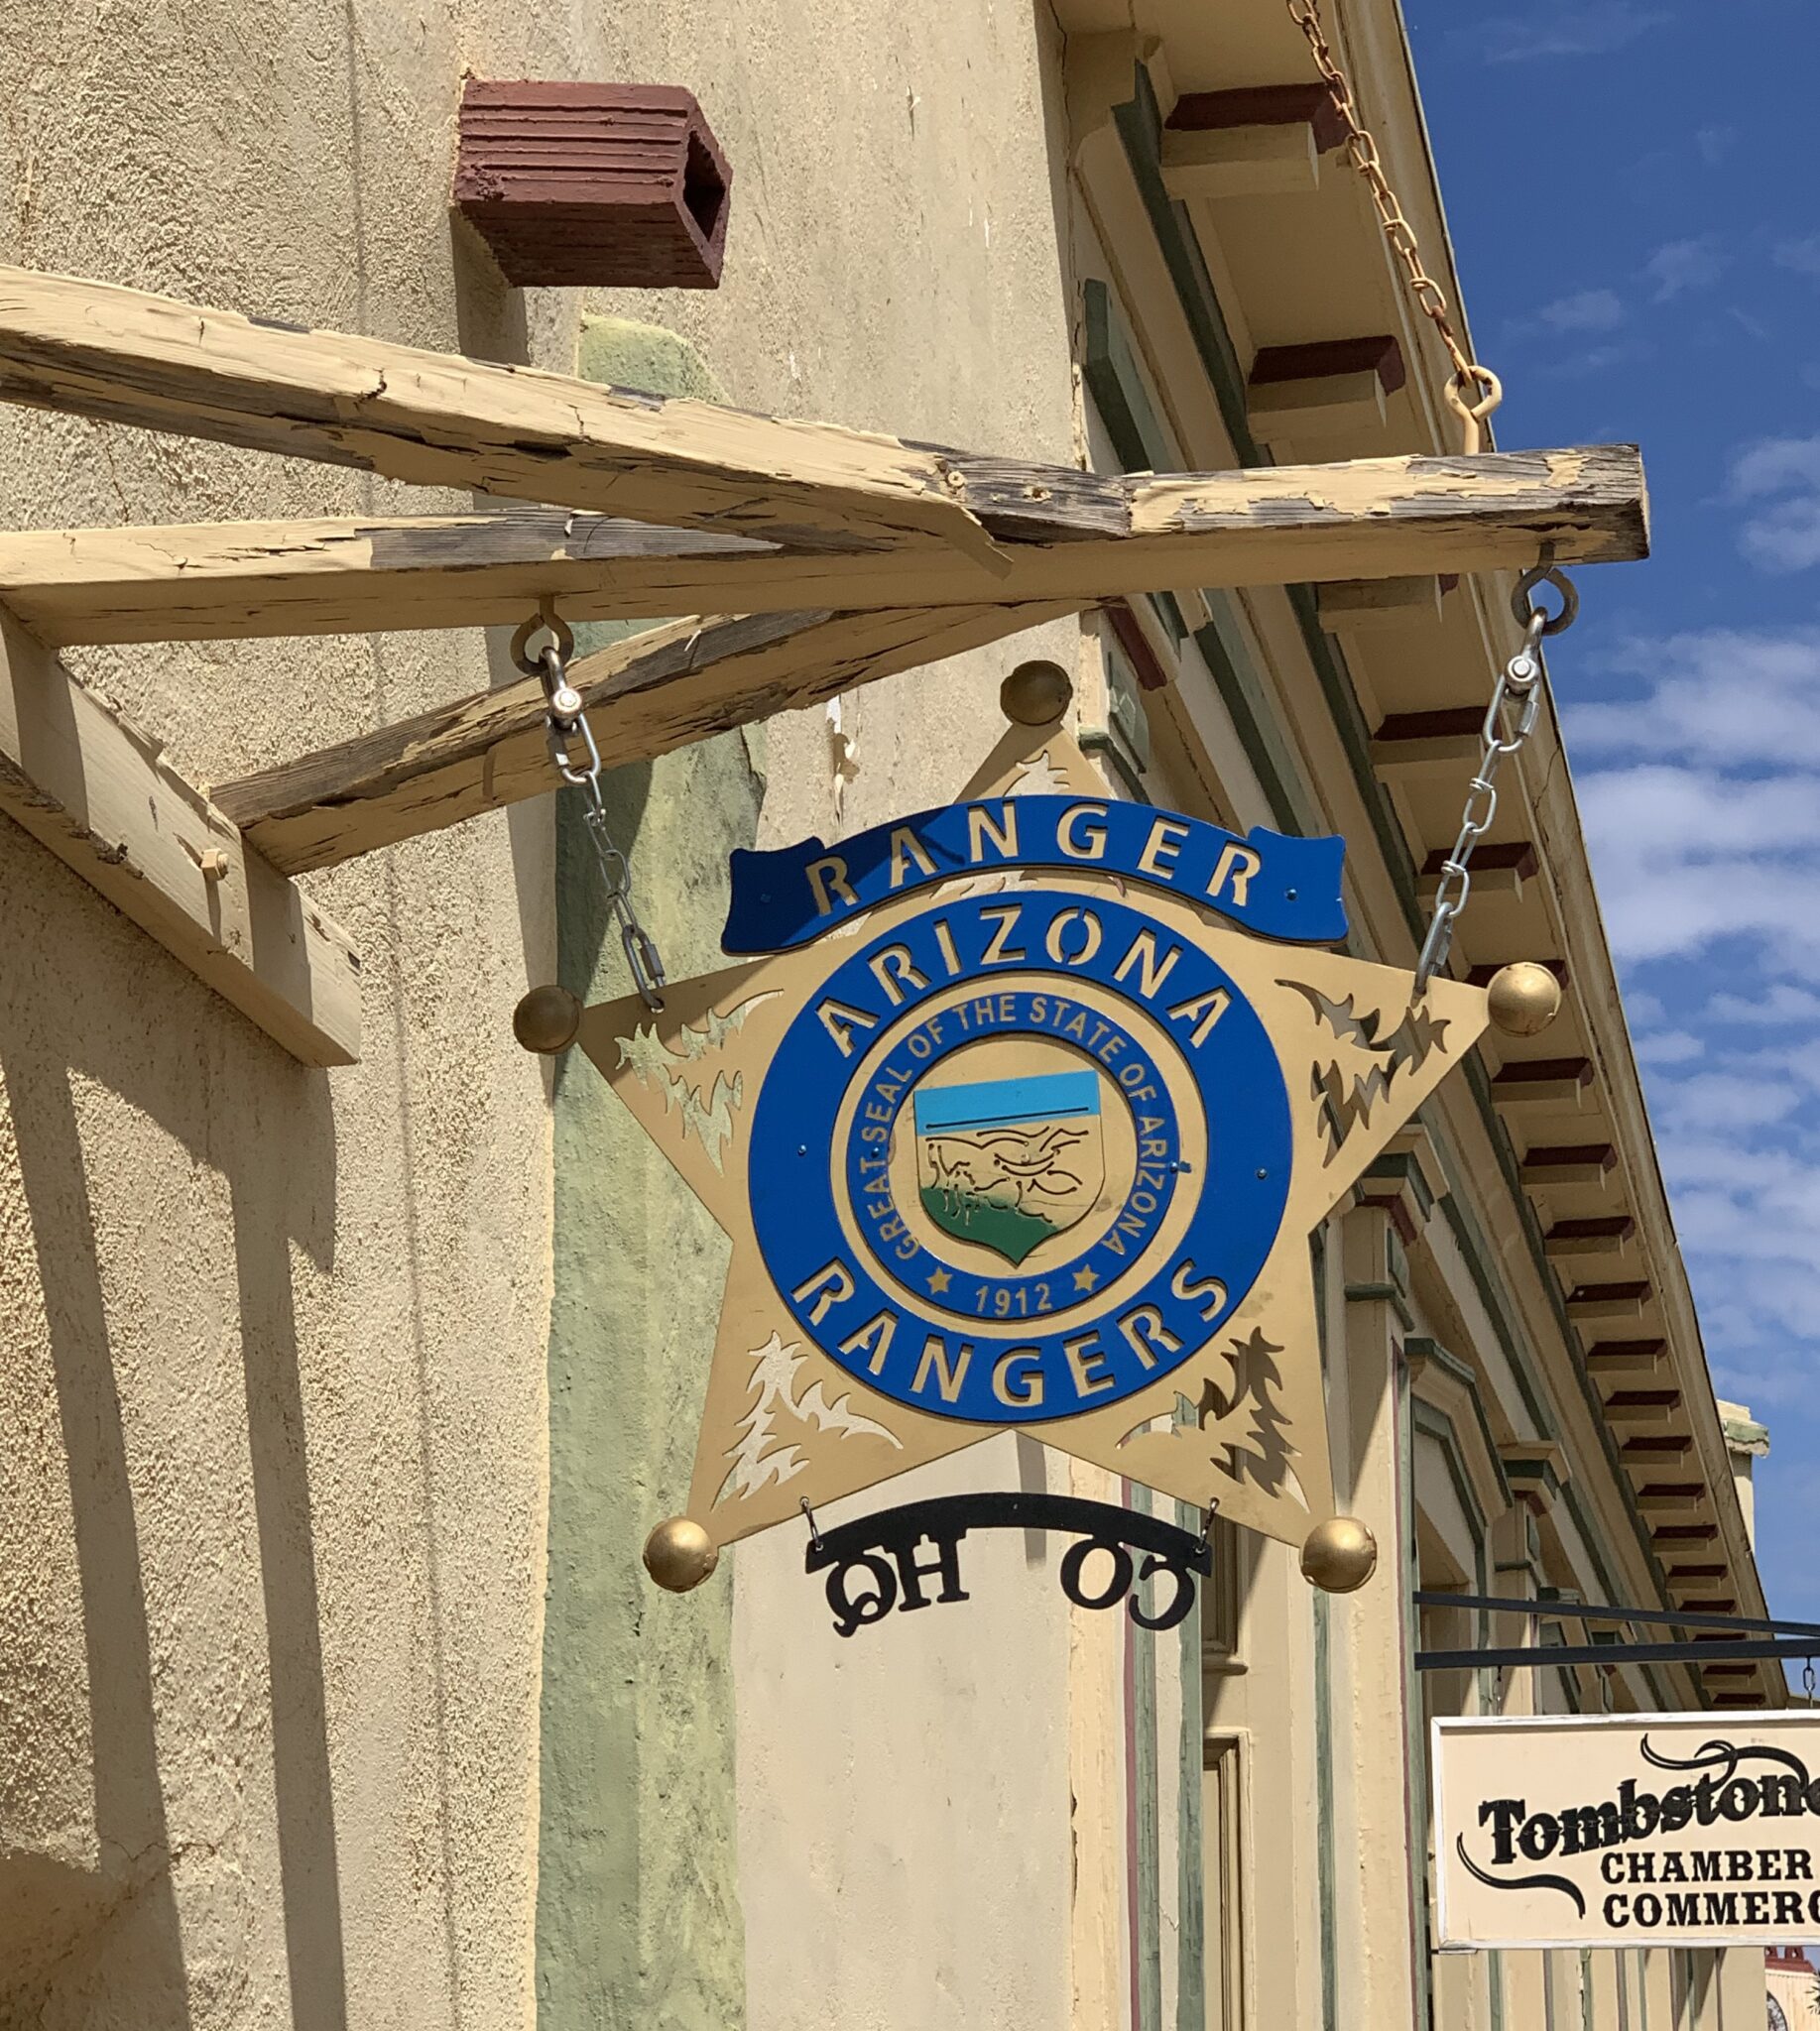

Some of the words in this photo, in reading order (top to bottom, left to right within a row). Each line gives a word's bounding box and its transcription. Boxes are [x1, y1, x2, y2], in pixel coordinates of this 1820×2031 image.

[804, 799, 1262, 917] RANGER
[814, 902, 1234, 1058] ARIZONA
[952, 996, 1018, 1031] THE
[908, 1018, 945, 1060] OF
[1029, 996, 1128, 1063] STATE
[862, 1067, 913, 1143] SEAL
[1119, 1062, 1157, 1103] OF
[860, 1155, 920, 1260] GREAT
[1101, 1116, 1167, 1256] ARIZONA
[790, 1256, 1230, 1407] RANGERS
[975, 1283, 1053, 1318] 1912
[1600, 1849, 1814, 1884] CHAMBER
